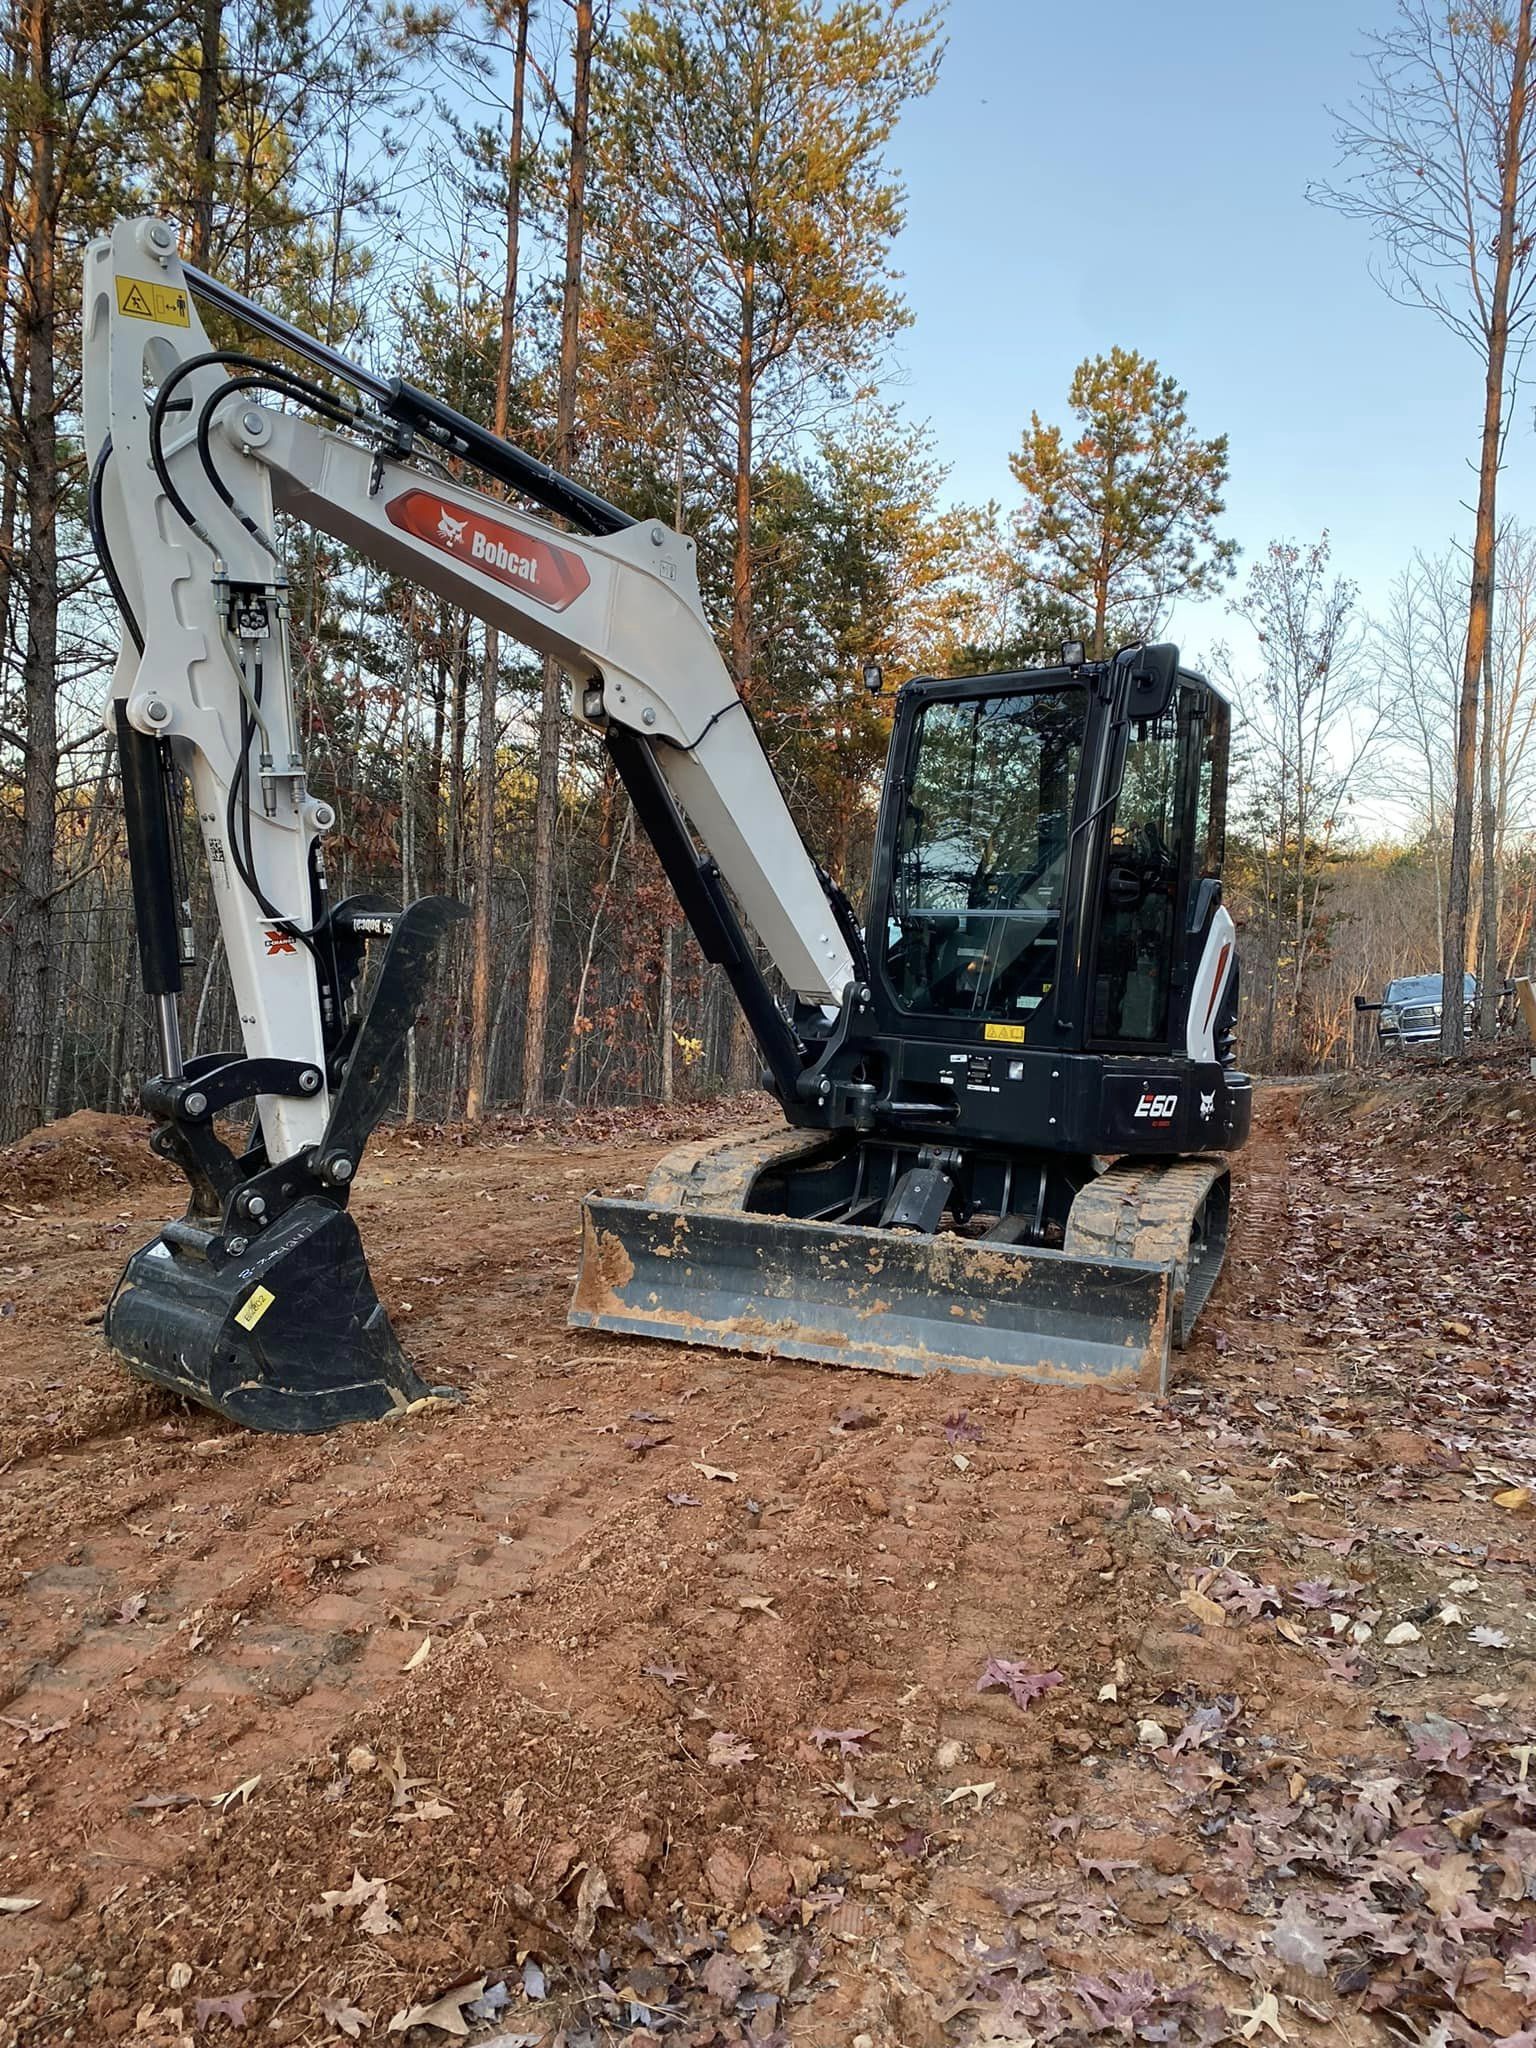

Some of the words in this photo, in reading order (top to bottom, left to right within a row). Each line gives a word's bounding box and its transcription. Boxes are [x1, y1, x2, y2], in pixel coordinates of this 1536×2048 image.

[472, 531, 537, 583] Bobcat
[353, 918, 381, 933] Bobcat
[1134, 1095, 1178, 1117] E60
